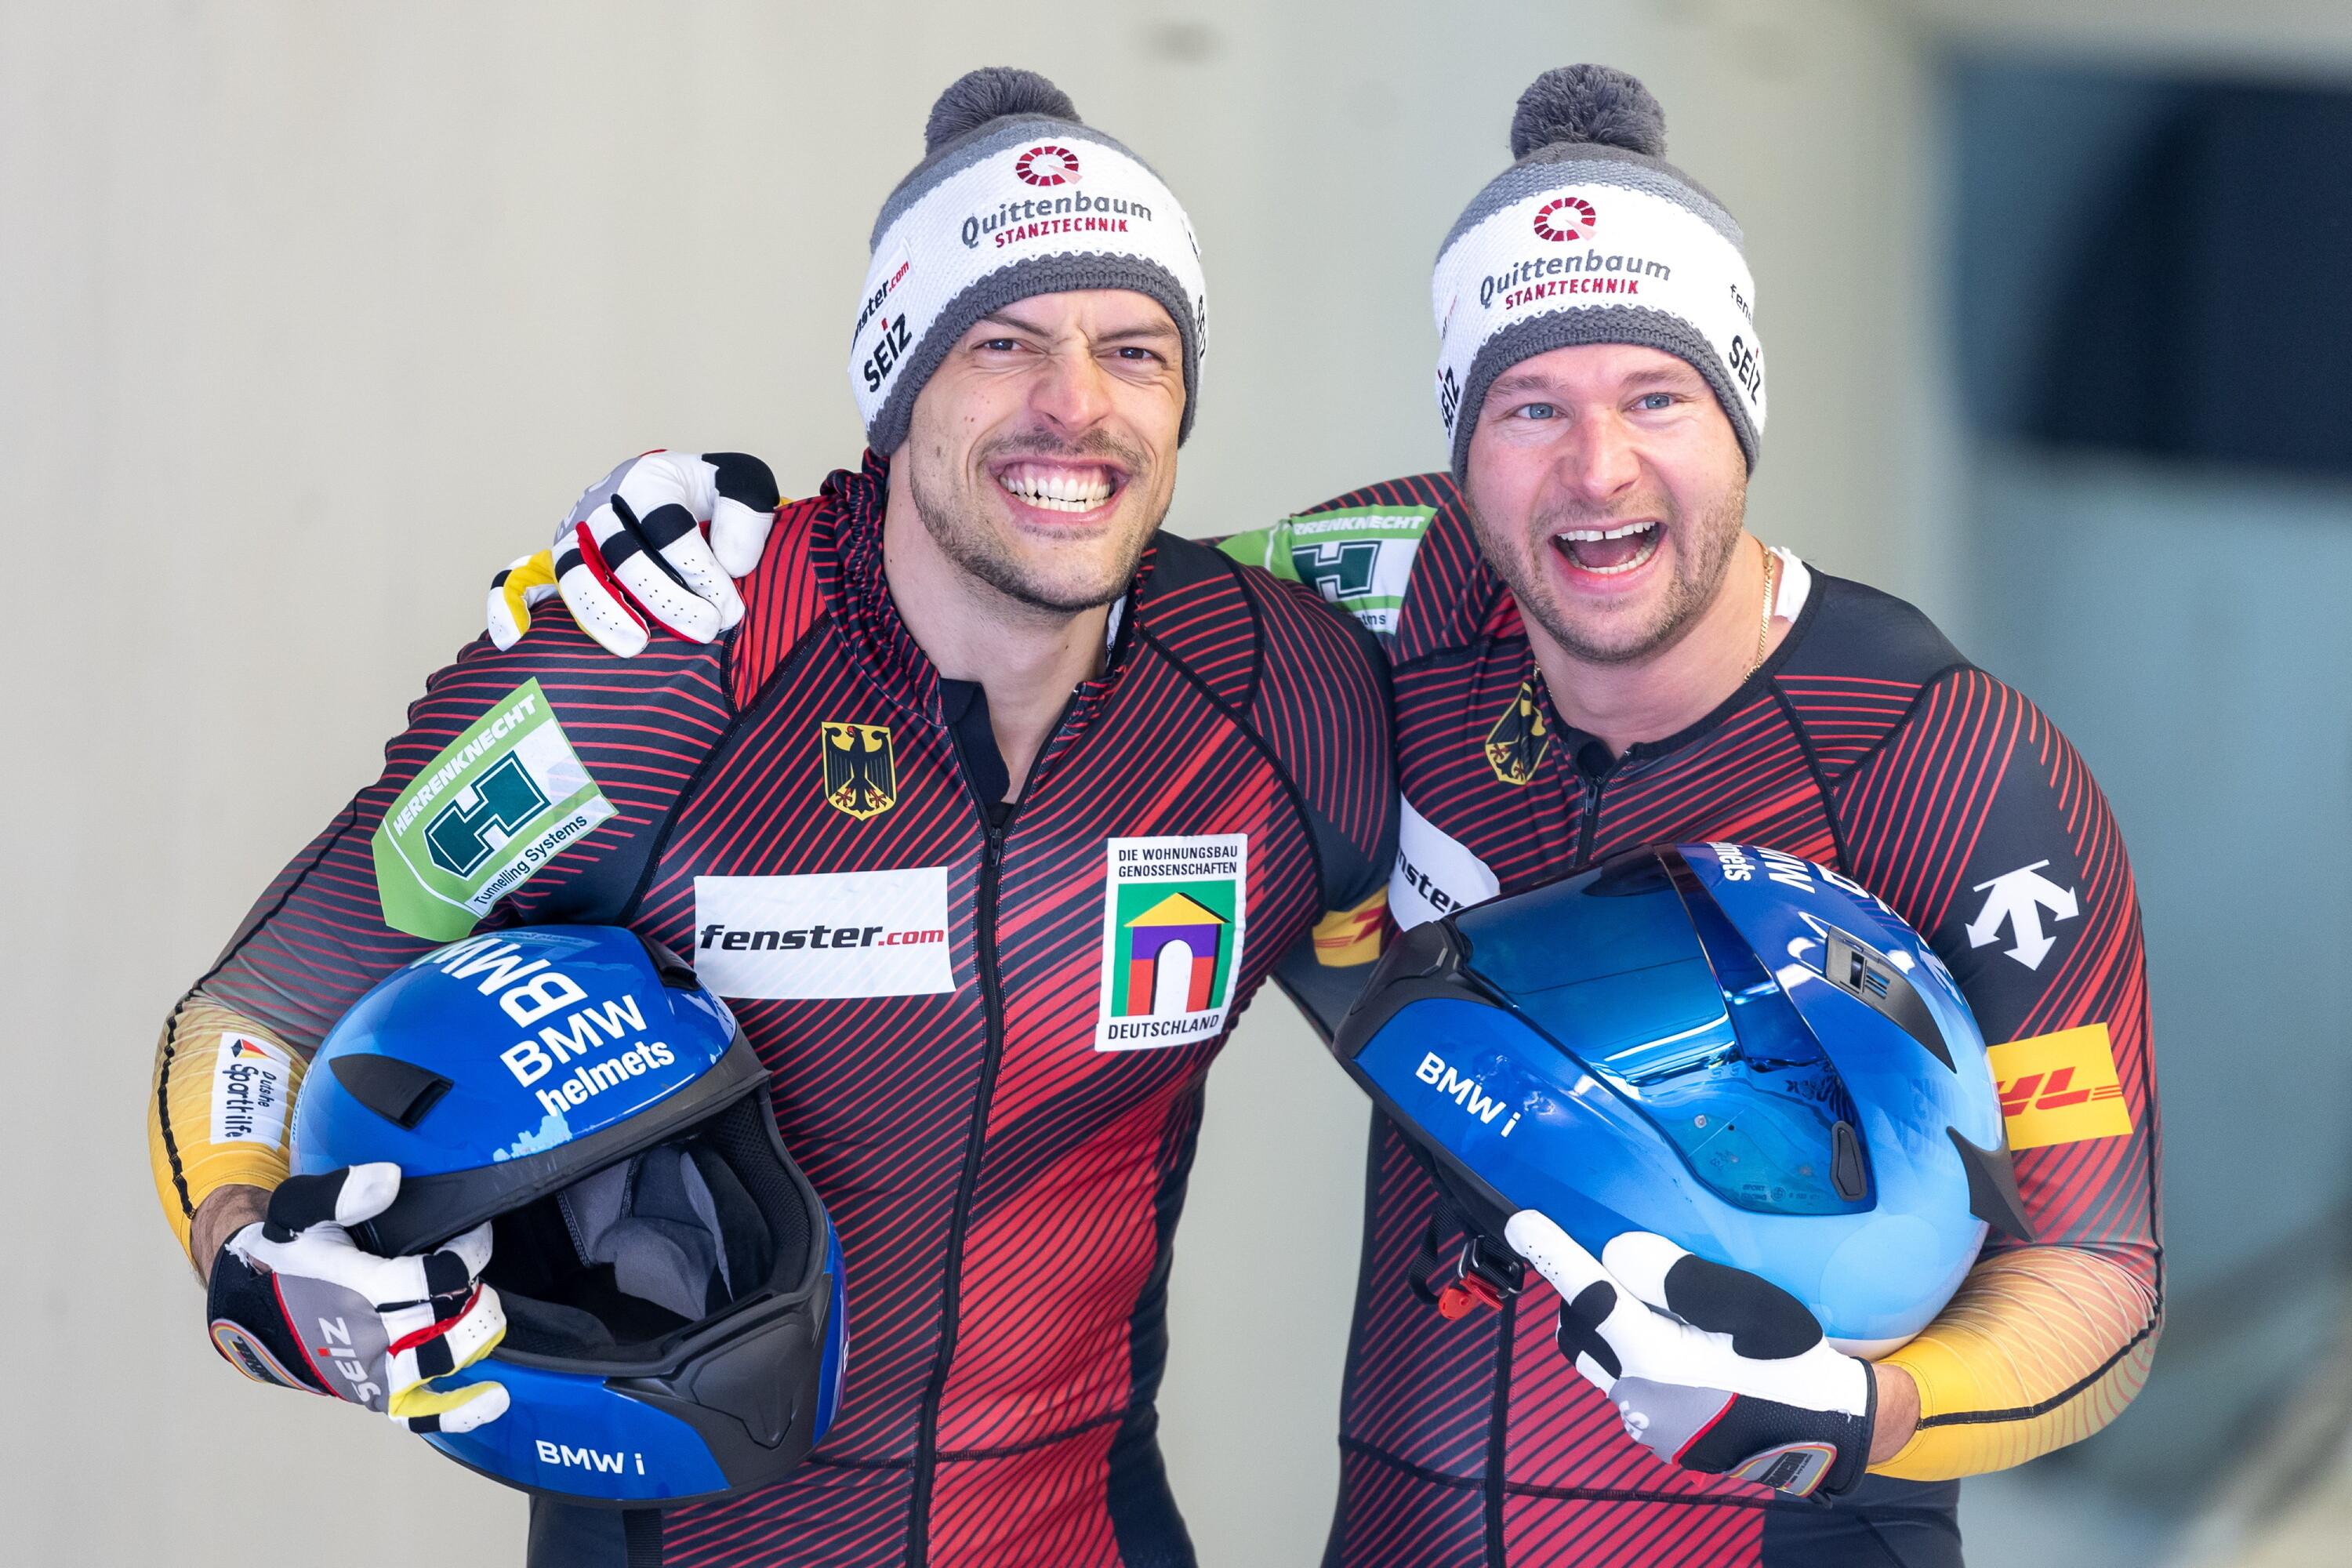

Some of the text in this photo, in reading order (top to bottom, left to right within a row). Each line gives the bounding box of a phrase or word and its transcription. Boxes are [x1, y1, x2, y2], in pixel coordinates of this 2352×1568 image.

[962, 191, 1152, 249] Quittenbaum
[995, 217, 1128, 248] STANZTECHNIK
[1480, 249, 1670, 309] Quittenbaum
[1505, 280, 1639, 311] STANZTECHNIK
[393, 694, 535, 837] HERRENKNECHT
[474, 815, 587, 905] Tunnelling Systems
[1119, 845, 1238, 862] DIE WOHNUNGSBAU
[1119, 862, 1236, 877] GENOSSENSCHAFTEN
[700, 924, 945, 951] fenster.com
[499, 994, 648, 1088] BMW
[1108, 1014, 1220, 1040] DEUTSCHLAND
[535, 1040, 676, 1117] helmets
[1415, 1051, 1522, 1138] BMW i
[535, 1439, 645, 1475] BMW i
